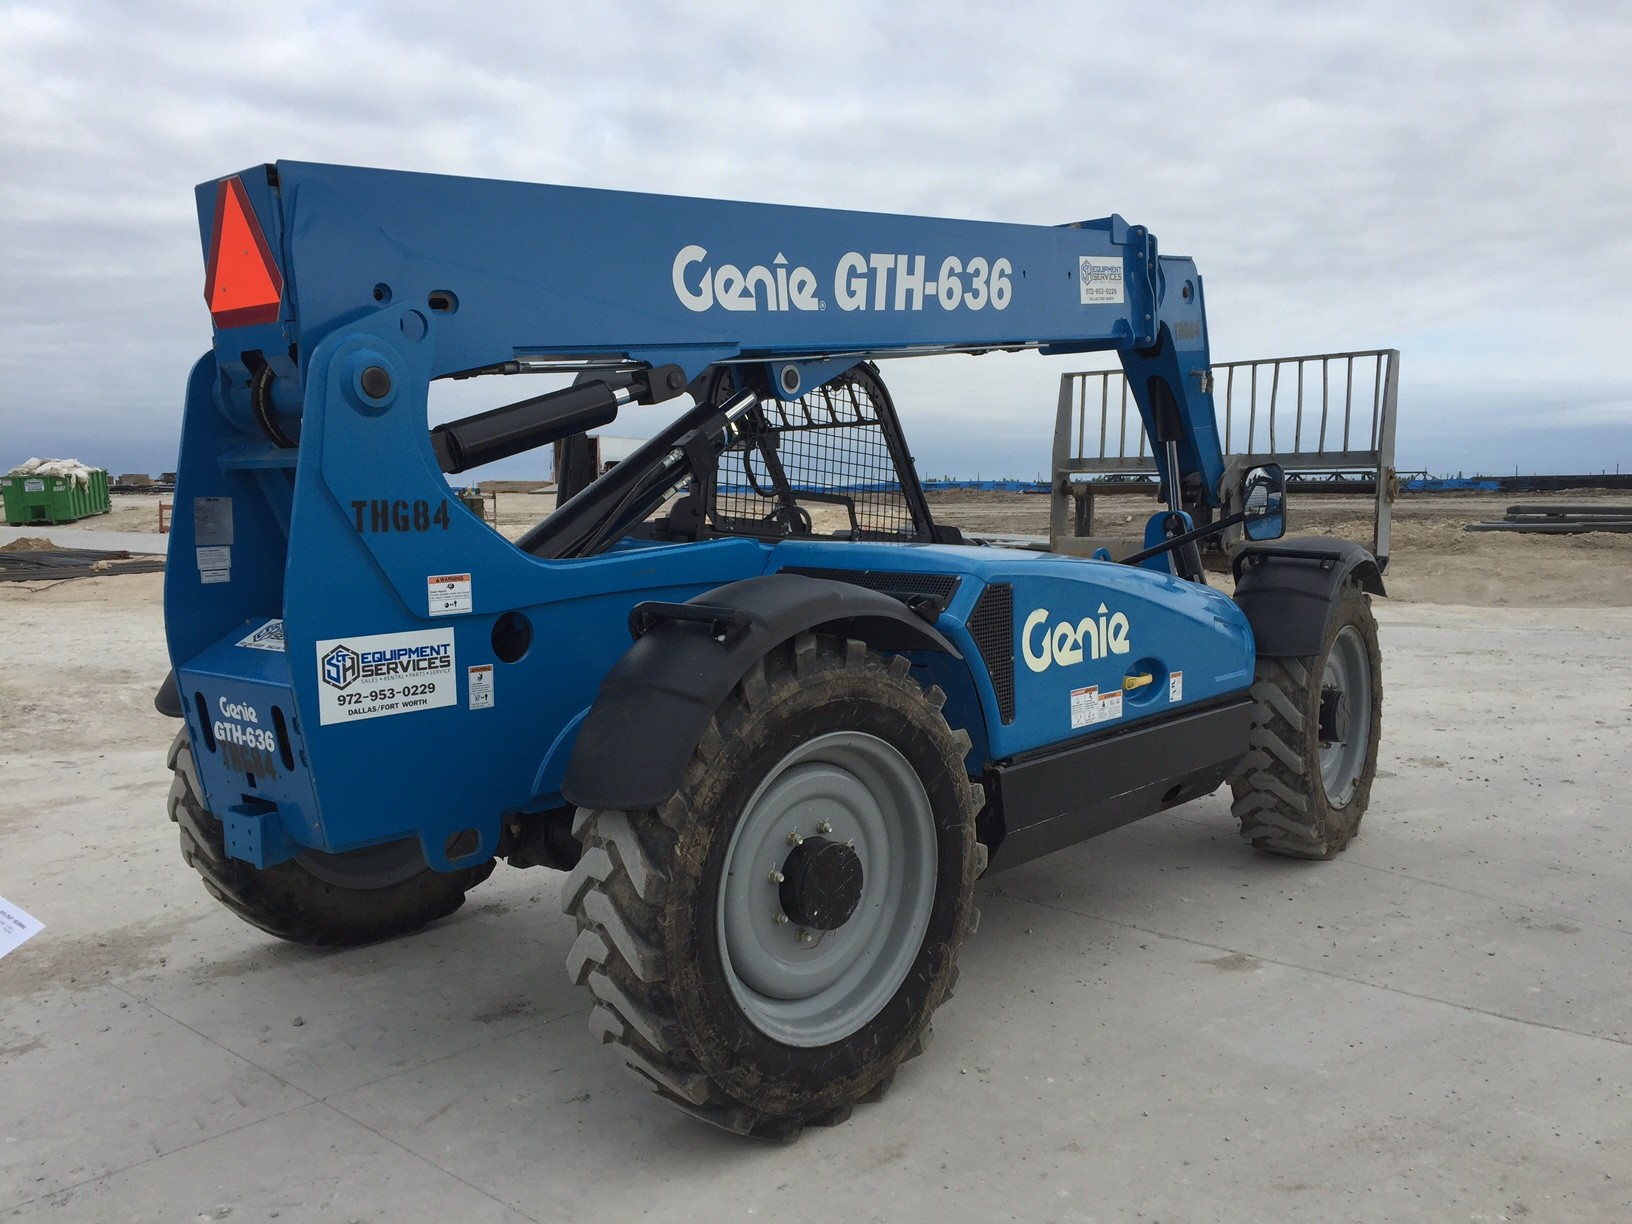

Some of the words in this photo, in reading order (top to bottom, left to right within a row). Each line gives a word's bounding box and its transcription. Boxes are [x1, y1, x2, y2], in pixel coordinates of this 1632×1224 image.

[672, 245, 819, 312] Genie
[834, 251, 1013, 311] GTH-636
[1093, 265, 1122, 273] EQUIPMENT
[1093, 273, 1122, 281] SERVICES
[351, 499, 450, 533] THG84
[440, 575, 464, 584] WARNING
[1022, 601, 1130, 673] Genie
[361, 643, 450, 665] EQUIPMENT
[361, 655, 451, 678] SERVICES
[337, 682, 436, 706] 972-953-0229
[402, 698, 428, 708] WORTH
[219, 696, 258, 723] Genie
[213, 720, 275, 753] GTH-636
